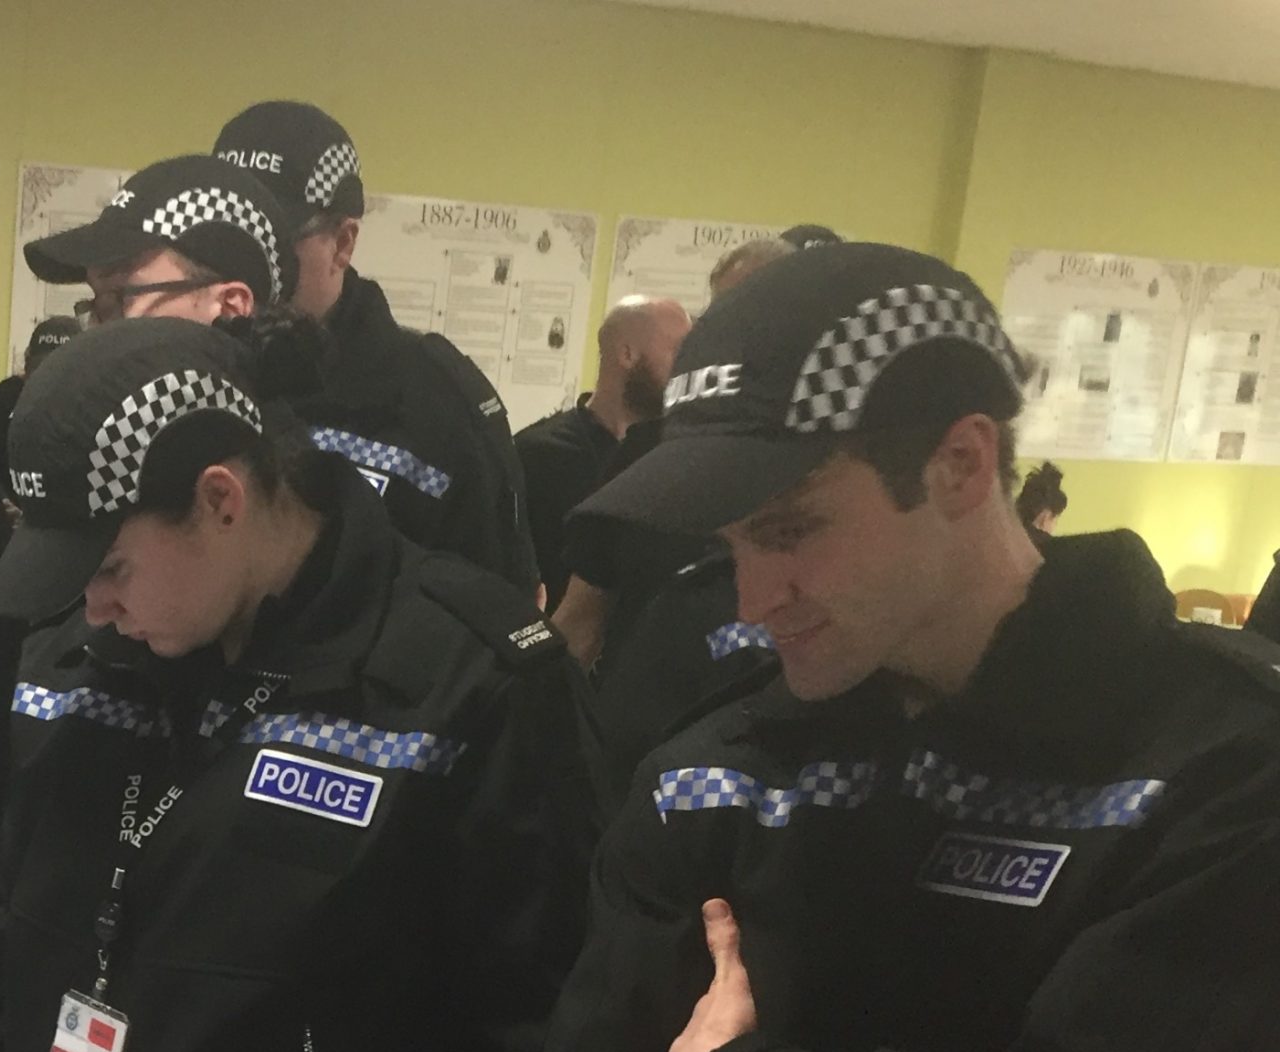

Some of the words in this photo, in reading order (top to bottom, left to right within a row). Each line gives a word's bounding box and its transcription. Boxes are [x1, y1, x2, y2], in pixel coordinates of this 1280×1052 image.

[420, 203, 517, 231] 1887-1906
[119, 774, 142, 842] POLICE
[258, 761, 366, 813] POLICE
[130, 785, 184, 848] POLICE
[940, 845, 1049, 890] POLICE
